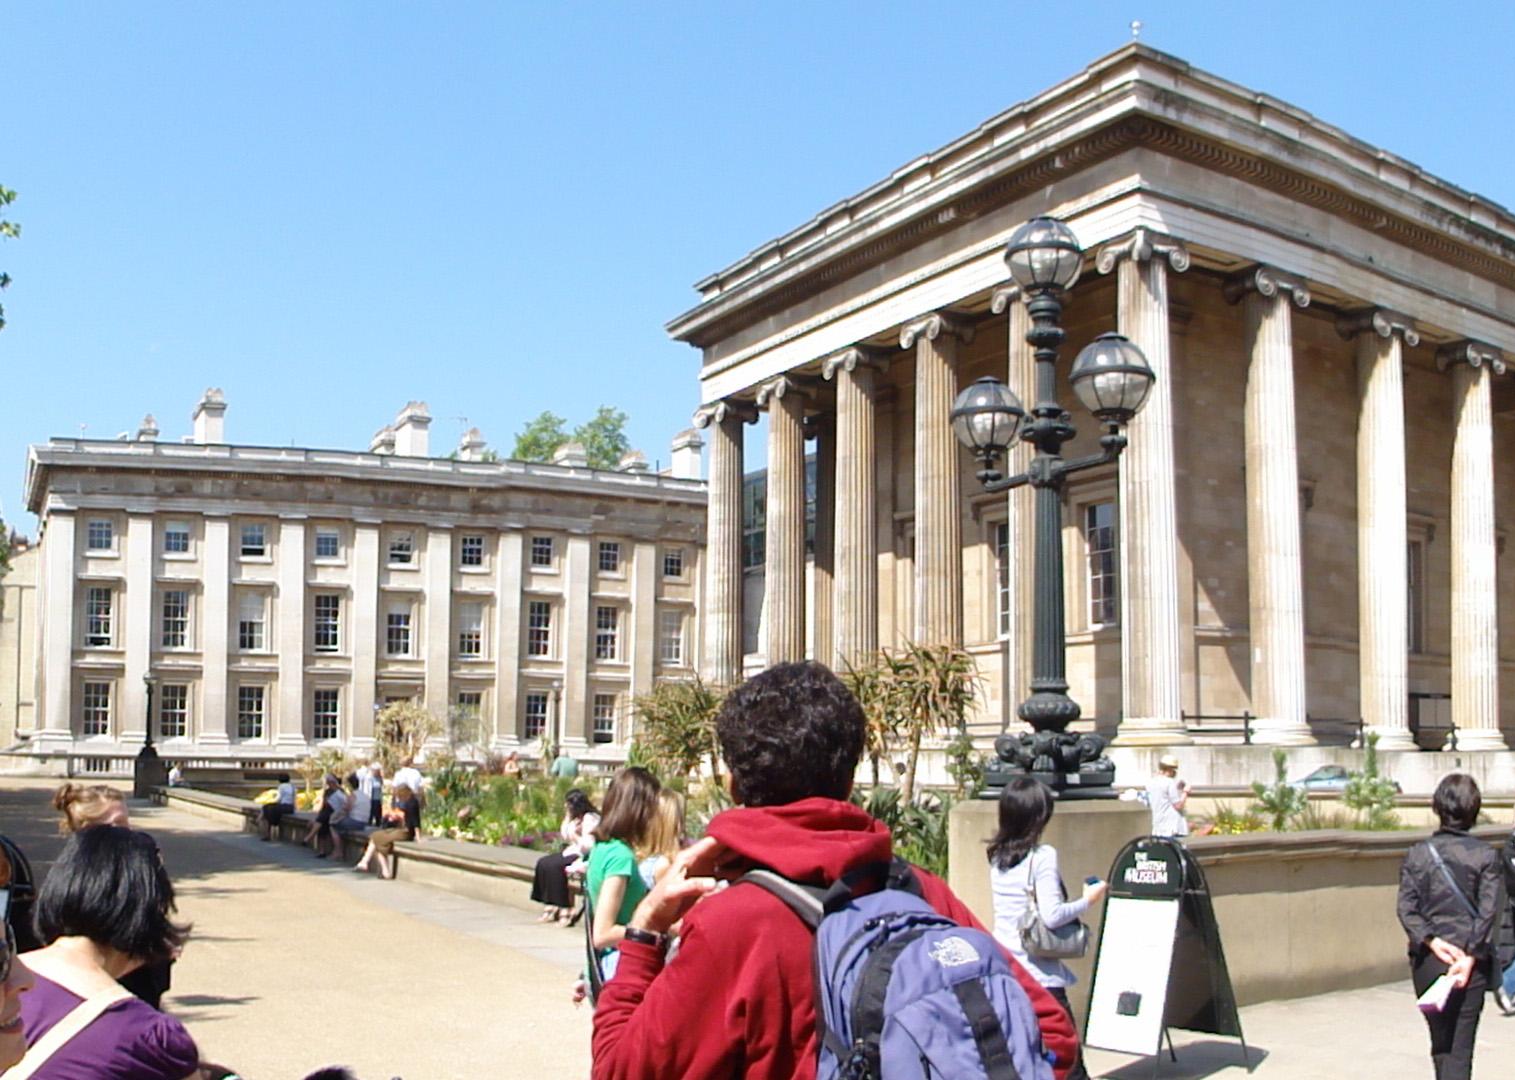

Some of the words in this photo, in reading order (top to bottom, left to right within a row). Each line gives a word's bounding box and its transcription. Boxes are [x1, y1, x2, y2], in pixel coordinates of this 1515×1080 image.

[1134, 851, 1148, 861] THE
[1136, 860, 1168, 871] BRITISH
[1124, 867, 1168, 884] MUSEUM
